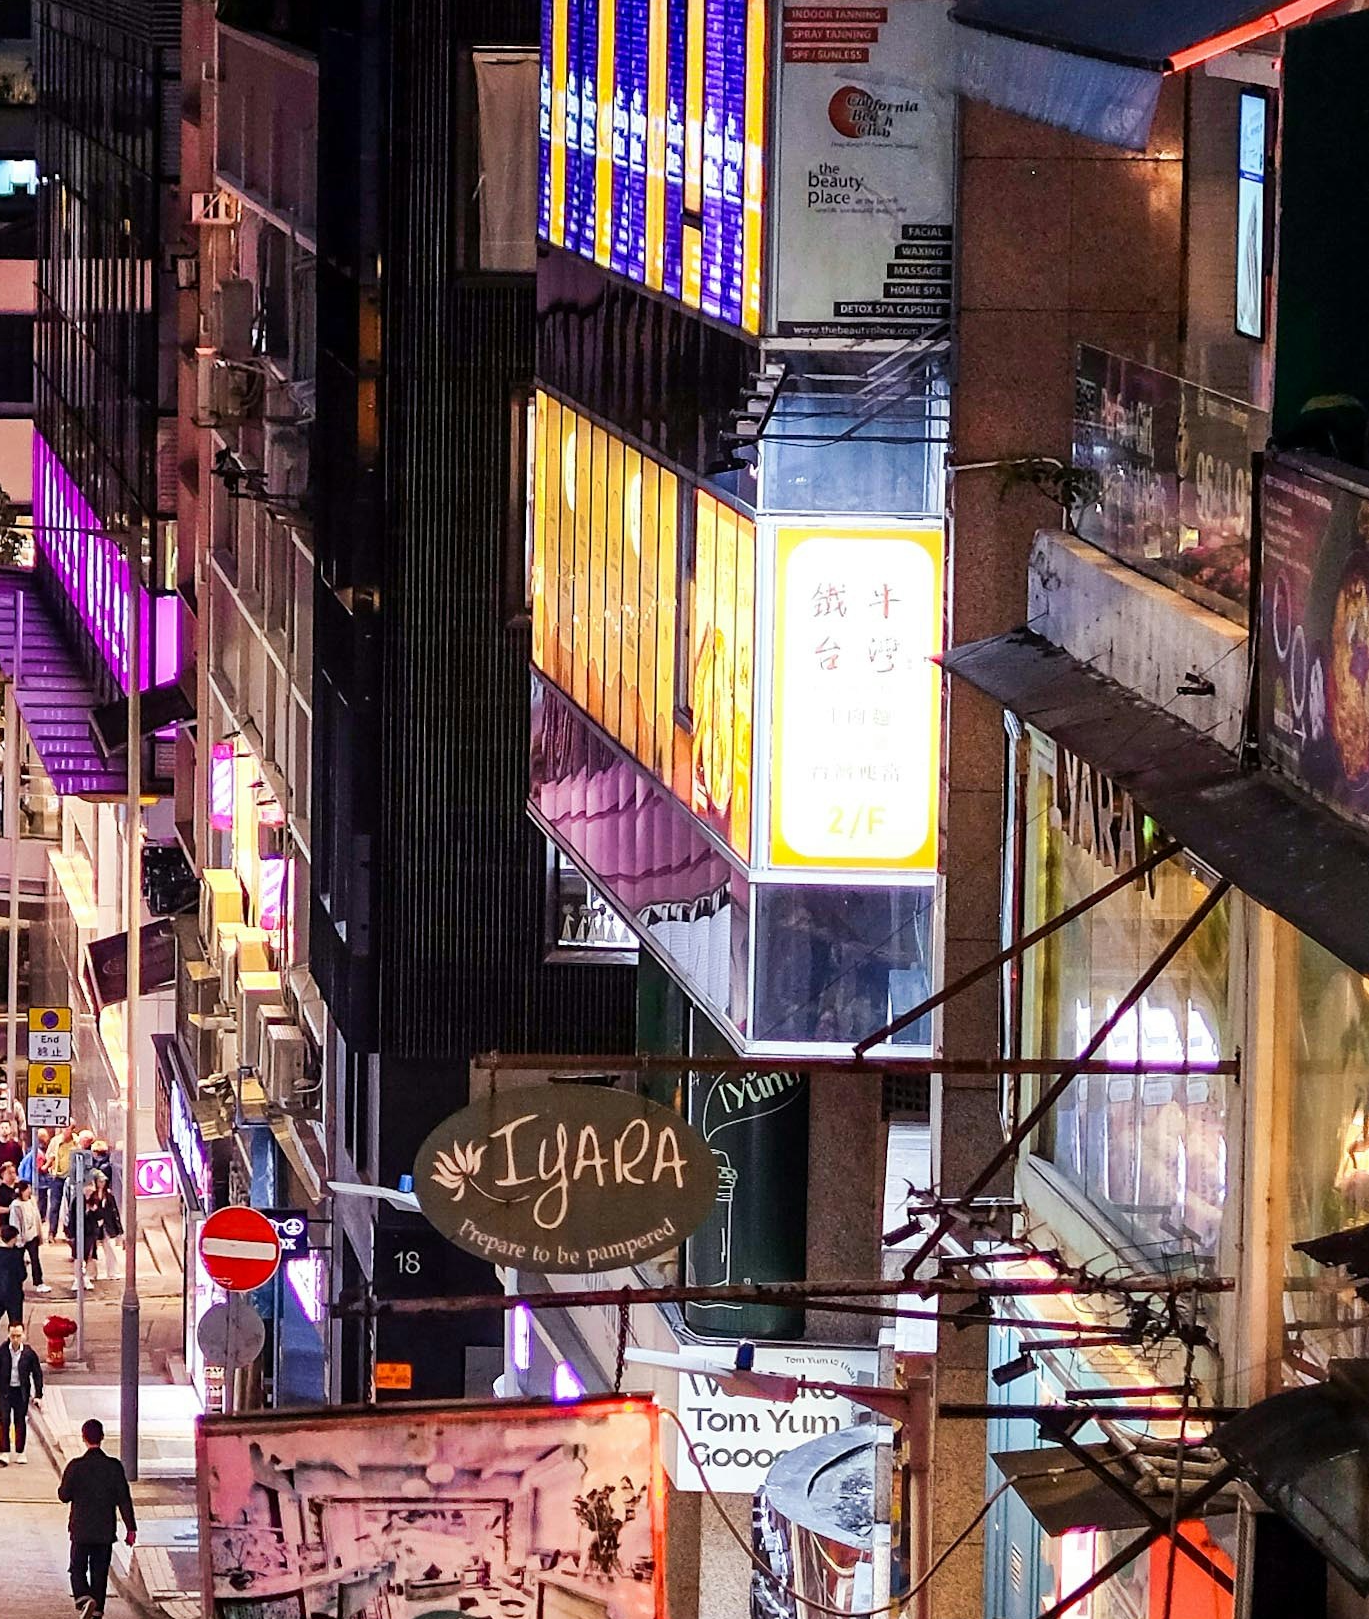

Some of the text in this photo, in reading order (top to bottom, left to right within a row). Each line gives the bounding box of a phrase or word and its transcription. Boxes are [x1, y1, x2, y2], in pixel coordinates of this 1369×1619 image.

[791, 9, 881, 20] INDOOR TANNING
[791, 29, 872, 40] SPRAY TANNING
[791, 49, 811, 60] SPF
[817, 49, 863, 60] SUNLESS
[846, 93, 919, 113] California
[851, 109, 893, 127] Beah
[819, 162, 840, 175] the
[808, 170, 864, 192] beauty
[808, 190, 851, 208] place
[908, 226, 943, 237] FACIAL
[901, 246, 944, 257] WAXING
[893, 265, 943, 276] MASSAGE
[890, 285, 942, 295] HOME SPA
[840, 304, 943, 315] DETOX SPA CAPSULE
[827, 804, 887, 839] 2/F
[40, 1035, 60, 1044] End
[54, 1115, 68, 1125] 12
[458, 1216, 677, 1268] Prepare to be pampered
[394, 1250, 421, 1275] 18
[784, 1355, 805, 1364] Tom
[807, 1356, 829, 1365] Yum
[687, 1406, 841, 1436] Tom Yum
[688, 1442, 790, 1469] Gooo
